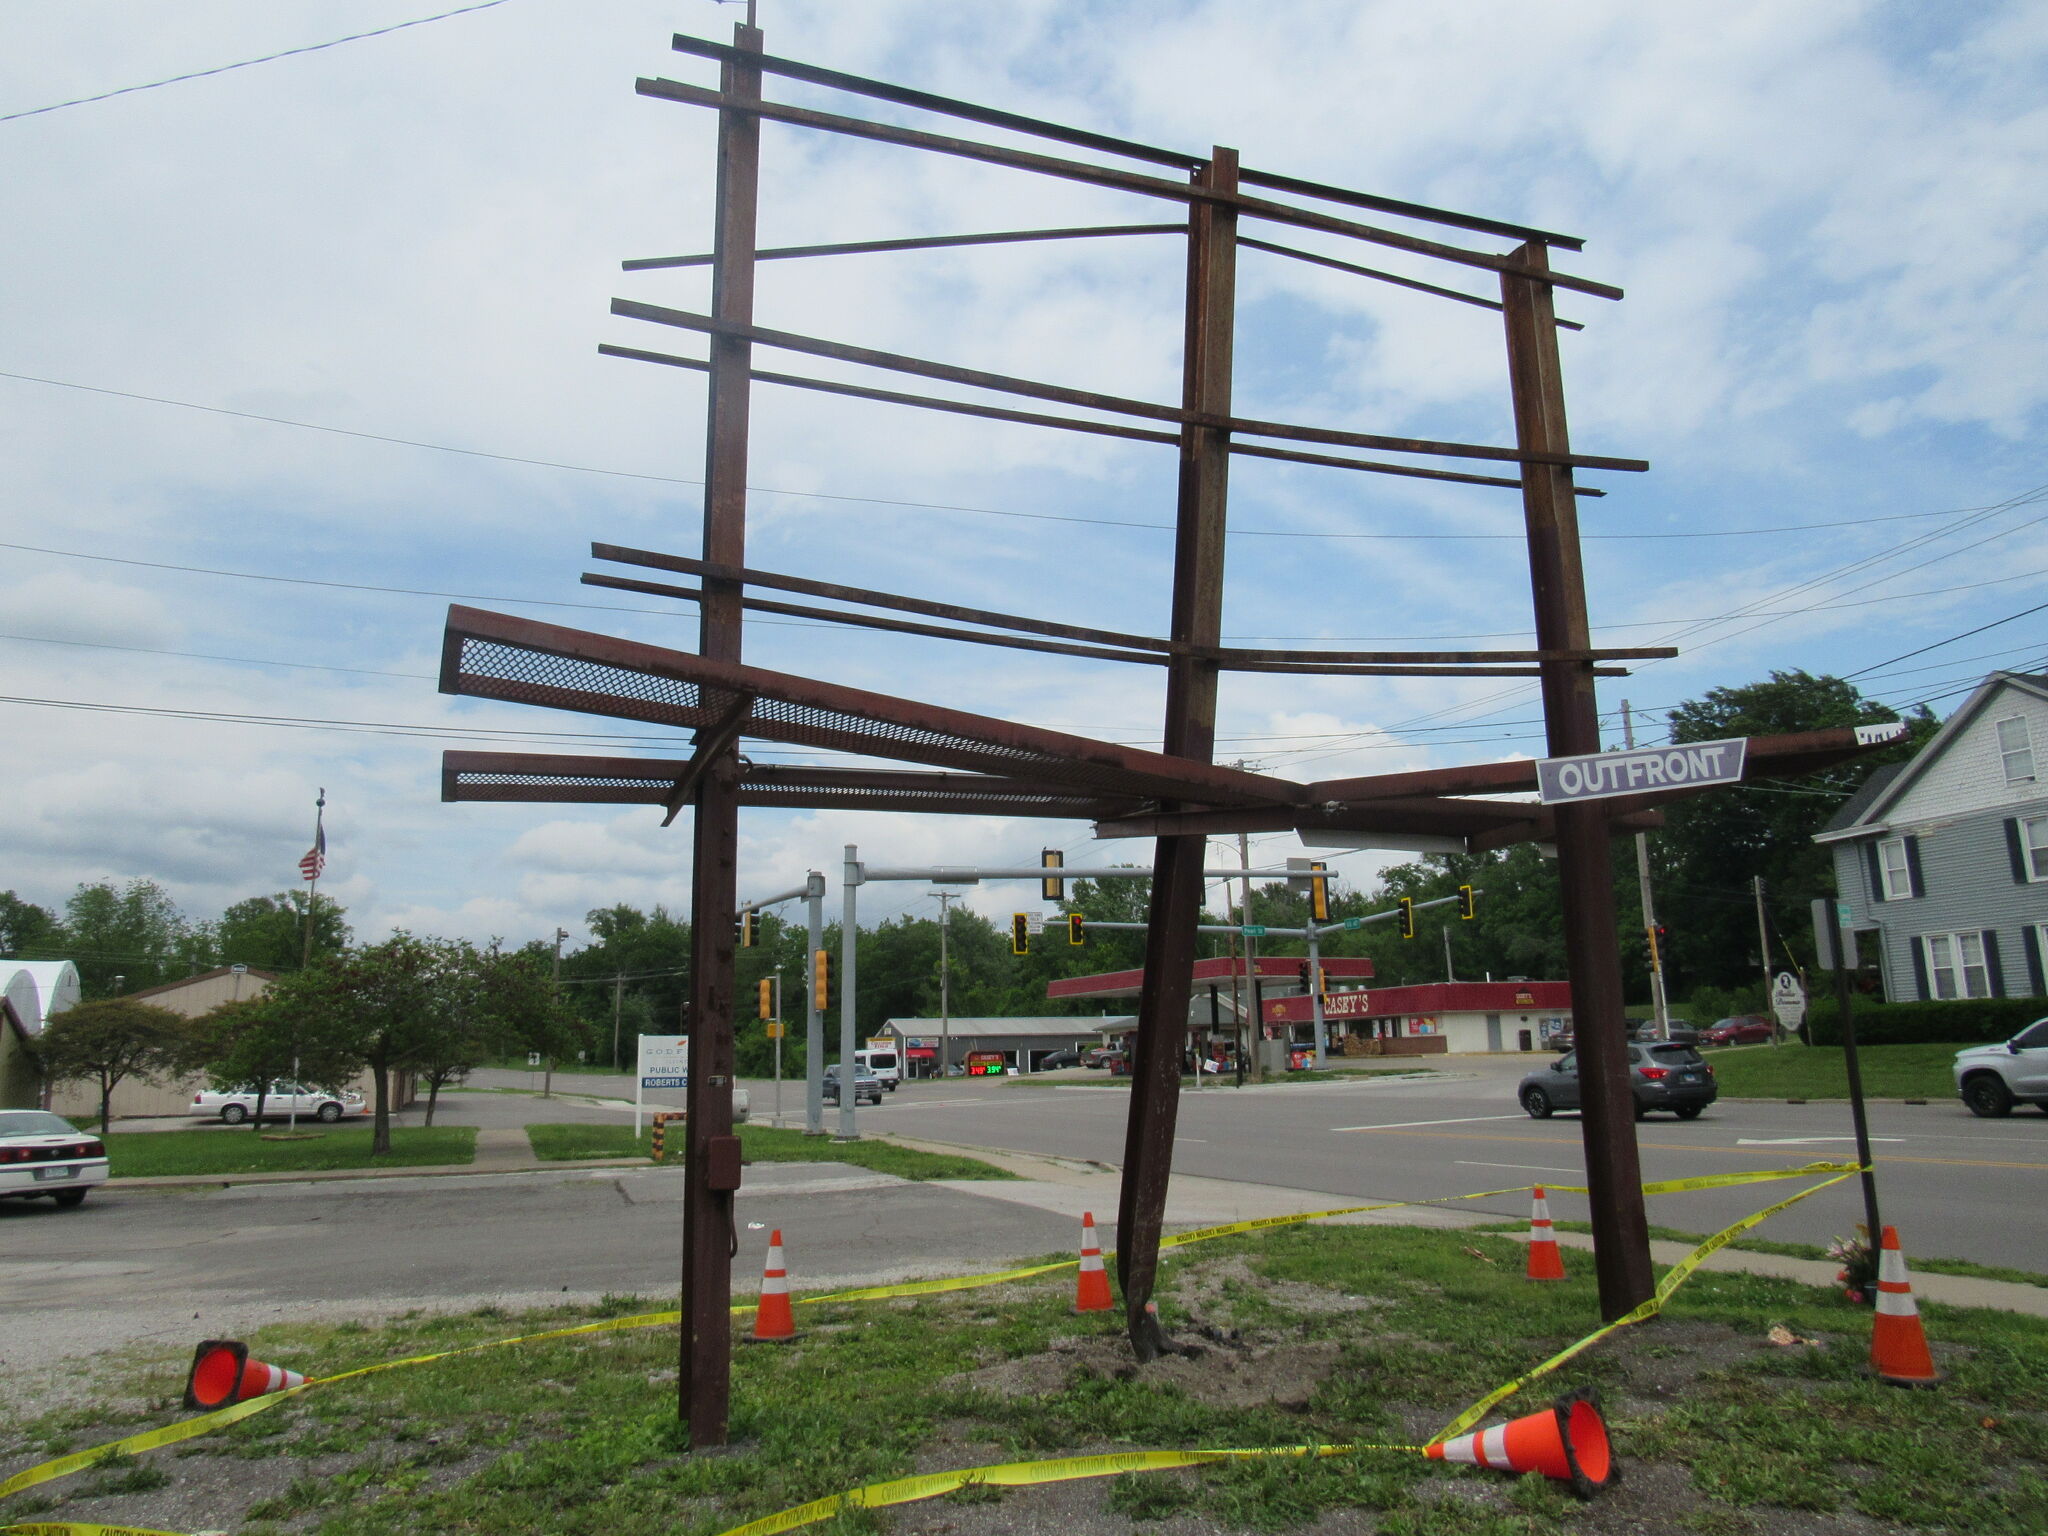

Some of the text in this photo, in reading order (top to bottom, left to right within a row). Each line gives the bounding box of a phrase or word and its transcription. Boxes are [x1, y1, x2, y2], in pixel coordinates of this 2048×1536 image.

[1558, 746, 1725, 795] OUTFRONT
[1324, 994, 1368, 1014] CASEY'S
[650, 1066, 680, 1074] PUBLIC
